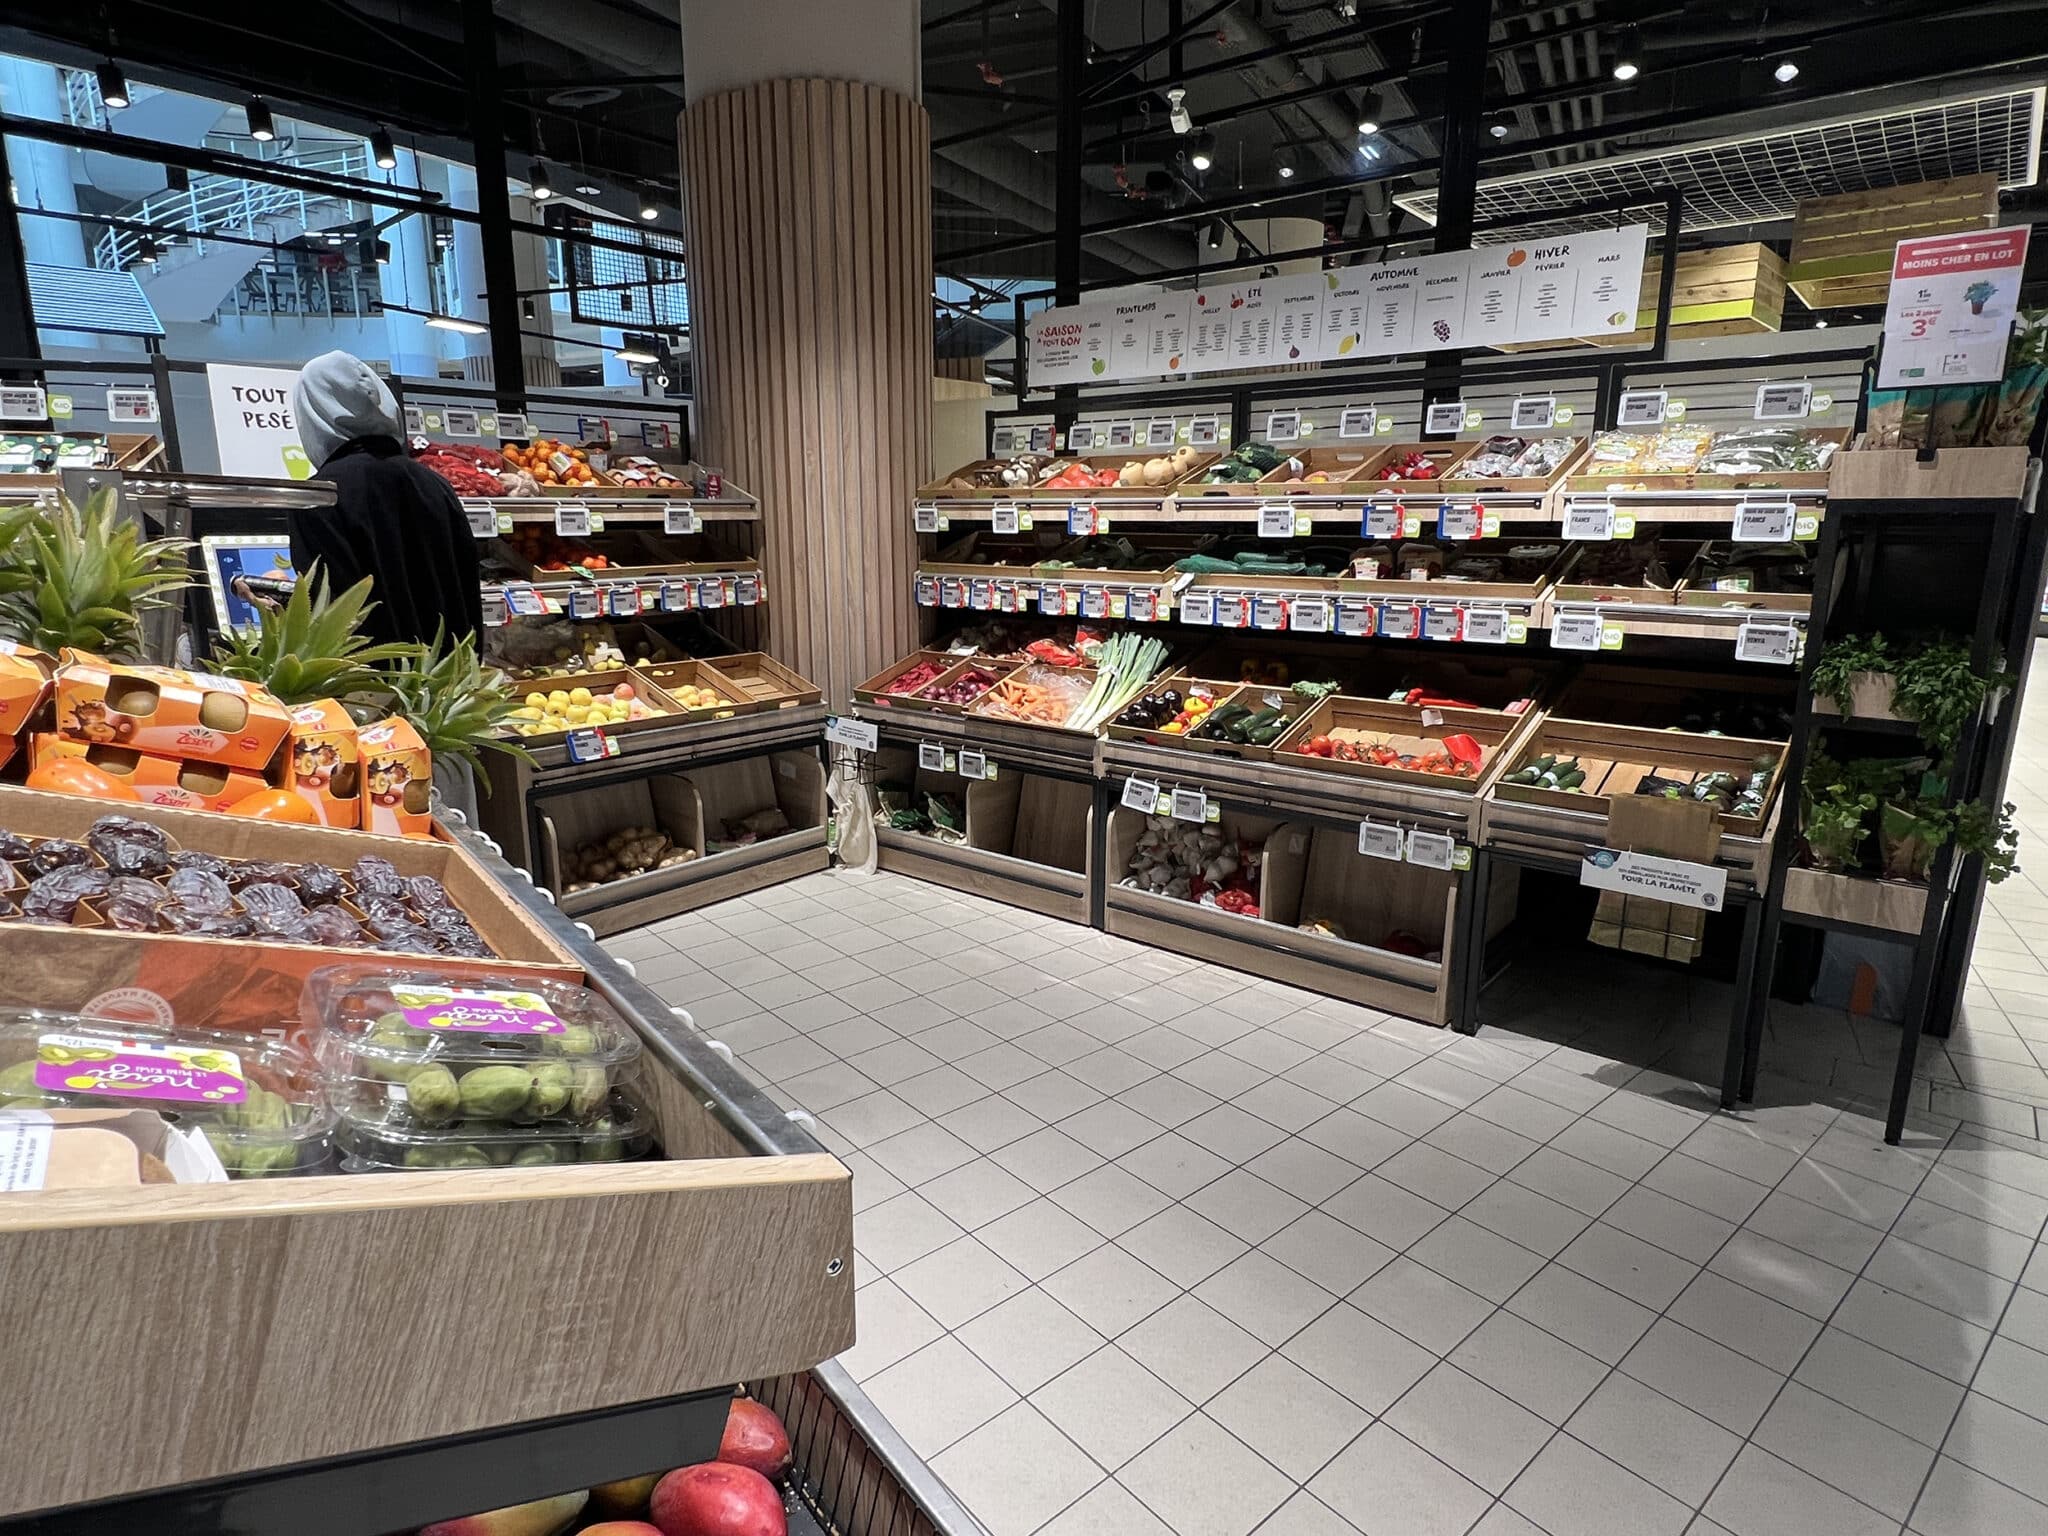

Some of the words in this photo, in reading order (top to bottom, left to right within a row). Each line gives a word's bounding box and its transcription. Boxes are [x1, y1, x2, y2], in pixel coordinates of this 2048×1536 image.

[1535, 246, 1570, 260] HIVER
[1598, 254, 1621, 263] MARS
[1903, 258, 1938, 270] MOINS
[1942, 255, 1972, 265] CHER
[1974, 252, 1989, 262] EN
[1992, 249, 2015, 259] LOT
[1370, 267, 1420, 281] AUTOMNE
[1481, 269, 1511, 279] JANVIER
[1116, 302, 1157, 315] PRINTEMPS
[1044, 324, 1082, 338] SAISON
[1060, 337, 1081, 346] BON
[231, 386, 288, 405] TOUT
[242, 409, 295, 430] PESÉ
[1621, 874, 1644, 885] POUR
[1645, 879, 1657, 887] LA
